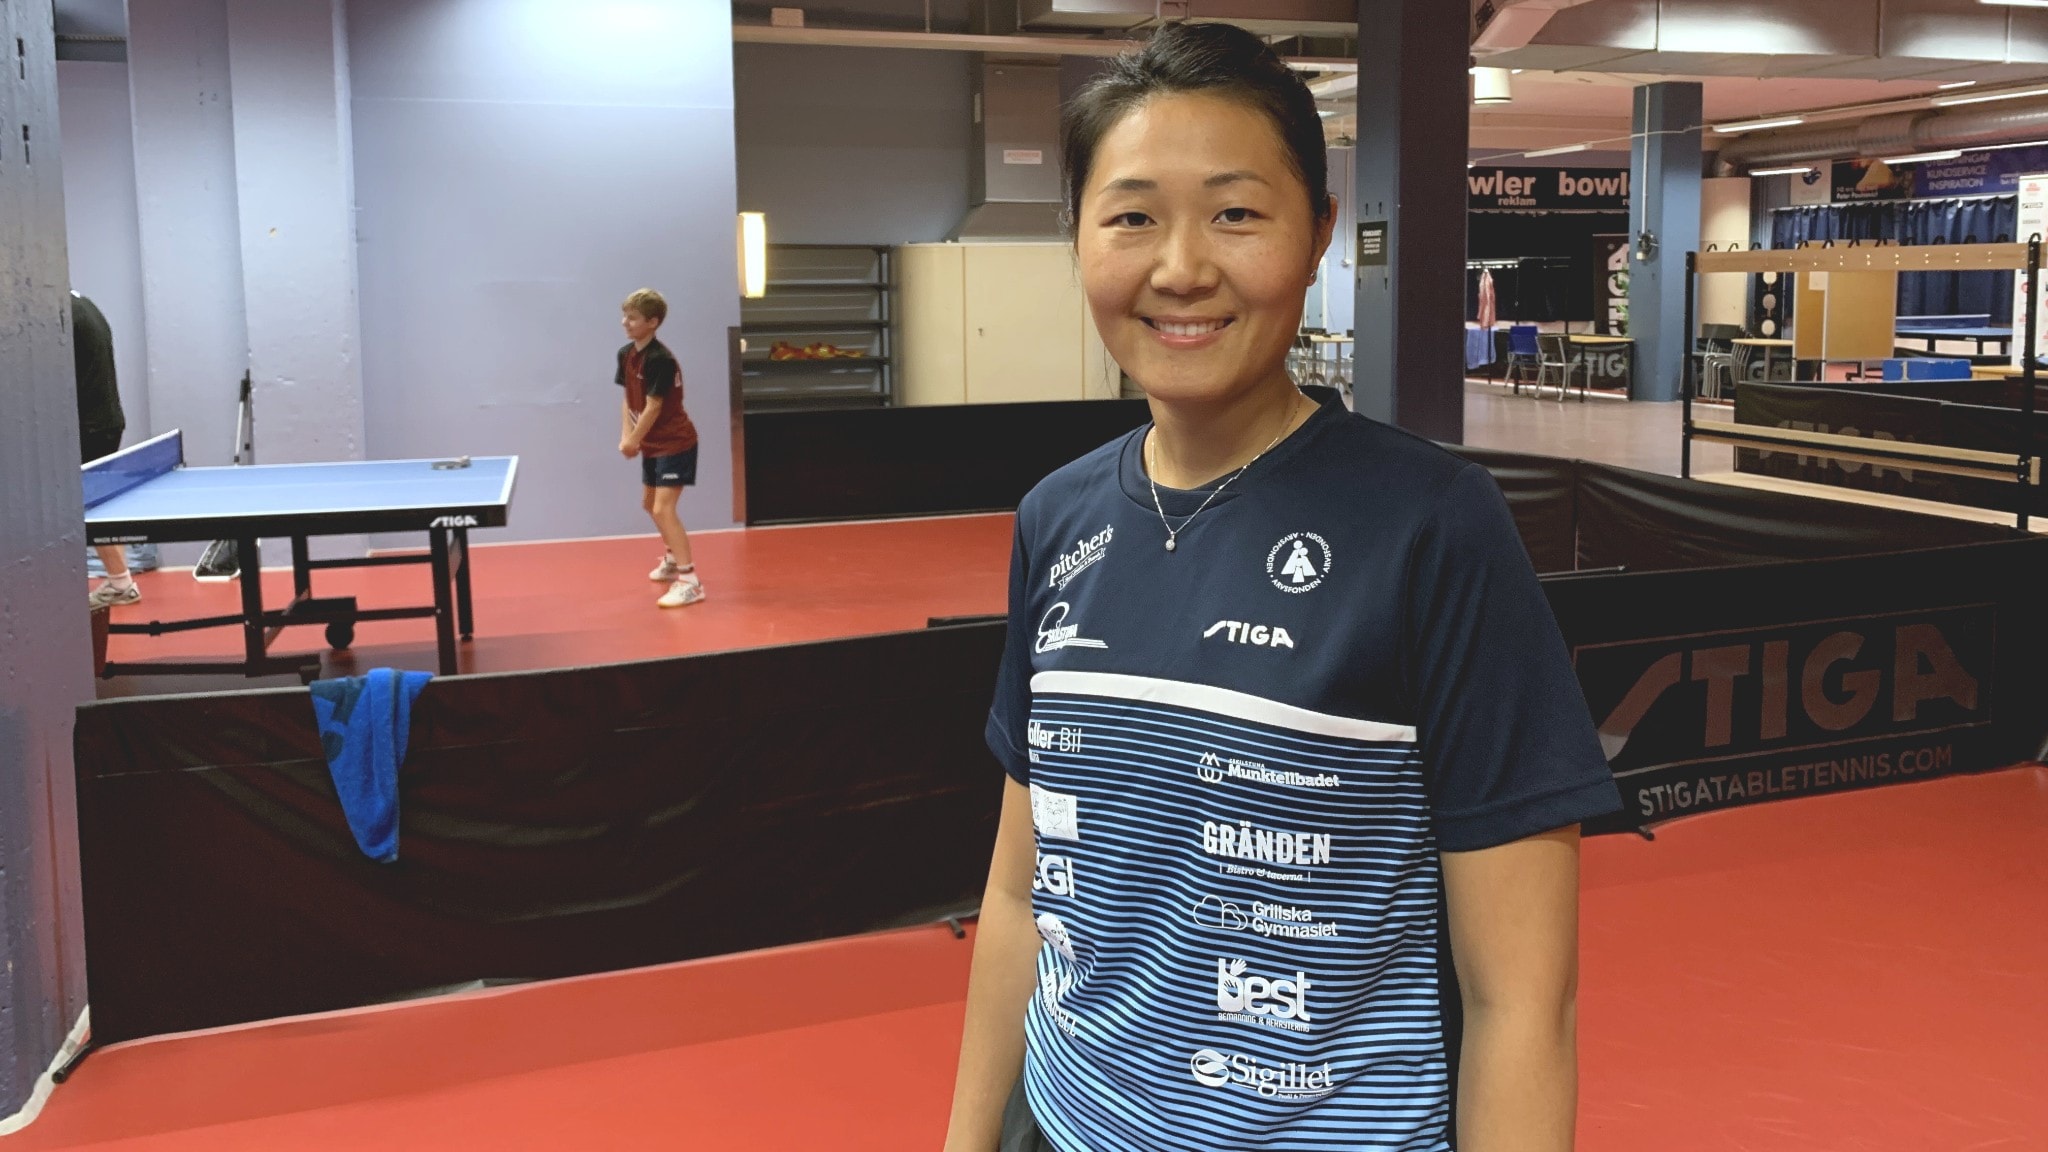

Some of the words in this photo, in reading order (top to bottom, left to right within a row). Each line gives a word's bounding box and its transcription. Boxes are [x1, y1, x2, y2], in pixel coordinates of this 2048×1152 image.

[1468, 170, 1536, 196] wler
[1558, 171, 1630, 197] bowl
[1928, 178, 1984, 191] INSPIRATION
[1498, 197, 1536, 206] reklam
[430, 514, 479, 528] STIGA
[1271, 577, 1322, 594] ARVSFONDEN
[1203, 620, 1294, 649] STIGA
[1599, 623, 1979, 763] STIGA
[1060, 726, 1082, 753] Bil
[1228, 763, 1340, 788] Munktellbadet
[1637, 744, 1953, 817] STIGATABLETENNIS.COM
[1203, 820, 1331, 865] GRÄNDEN
[1226, 863, 1255, 876] Bistro
[1266, 870, 1304, 882] taverna
[1252, 900, 1313, 922] Grillska
[1252, 916, 1339, 938] Gymnasiet
[1258, 1017, 1265, 1026] &
[1231, 1053, 1335, 1098] Sigillet
